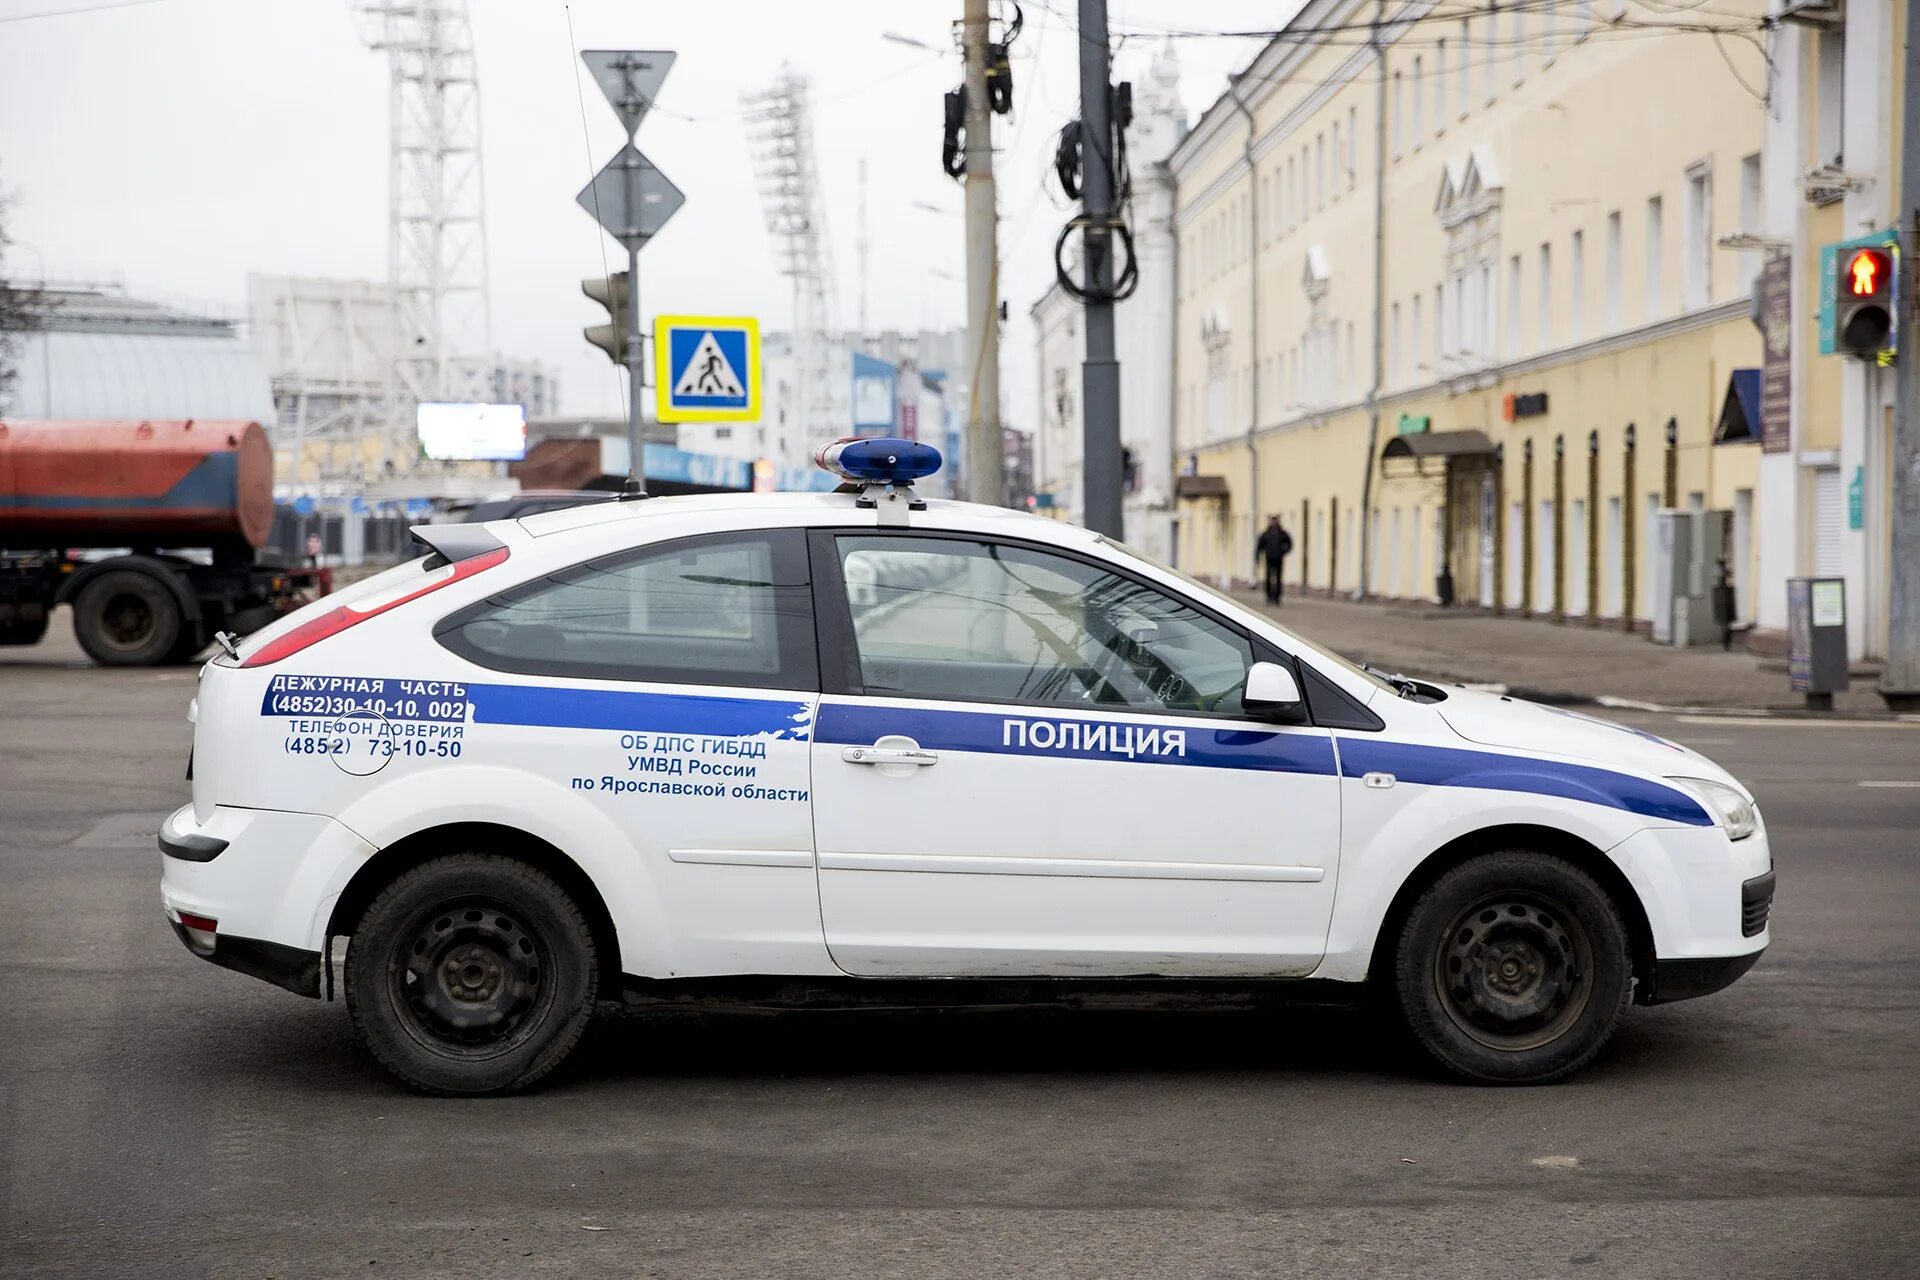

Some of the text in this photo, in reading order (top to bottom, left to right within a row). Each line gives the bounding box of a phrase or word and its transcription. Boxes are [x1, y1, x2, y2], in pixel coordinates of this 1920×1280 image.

[272, 676, 466, 697] ДЕЖУРНАЯ ЧАСТЬ
[272, 694, 464, 718] (4852)30-10-10, 002
[289, 720, 464, 738] ТЕЛЕФОН ДОВЕРИЯ
[1003, 719, 1186, 759] ПОЛИЦИЯ
[369, 740, 462, 758] 73-10-50
[620, 734, 766, 759] ОБ ДПС ГИБДД
[628, 756, 756, 778] УМВД России
[572, 776, 809, 802] по Ярославской области
